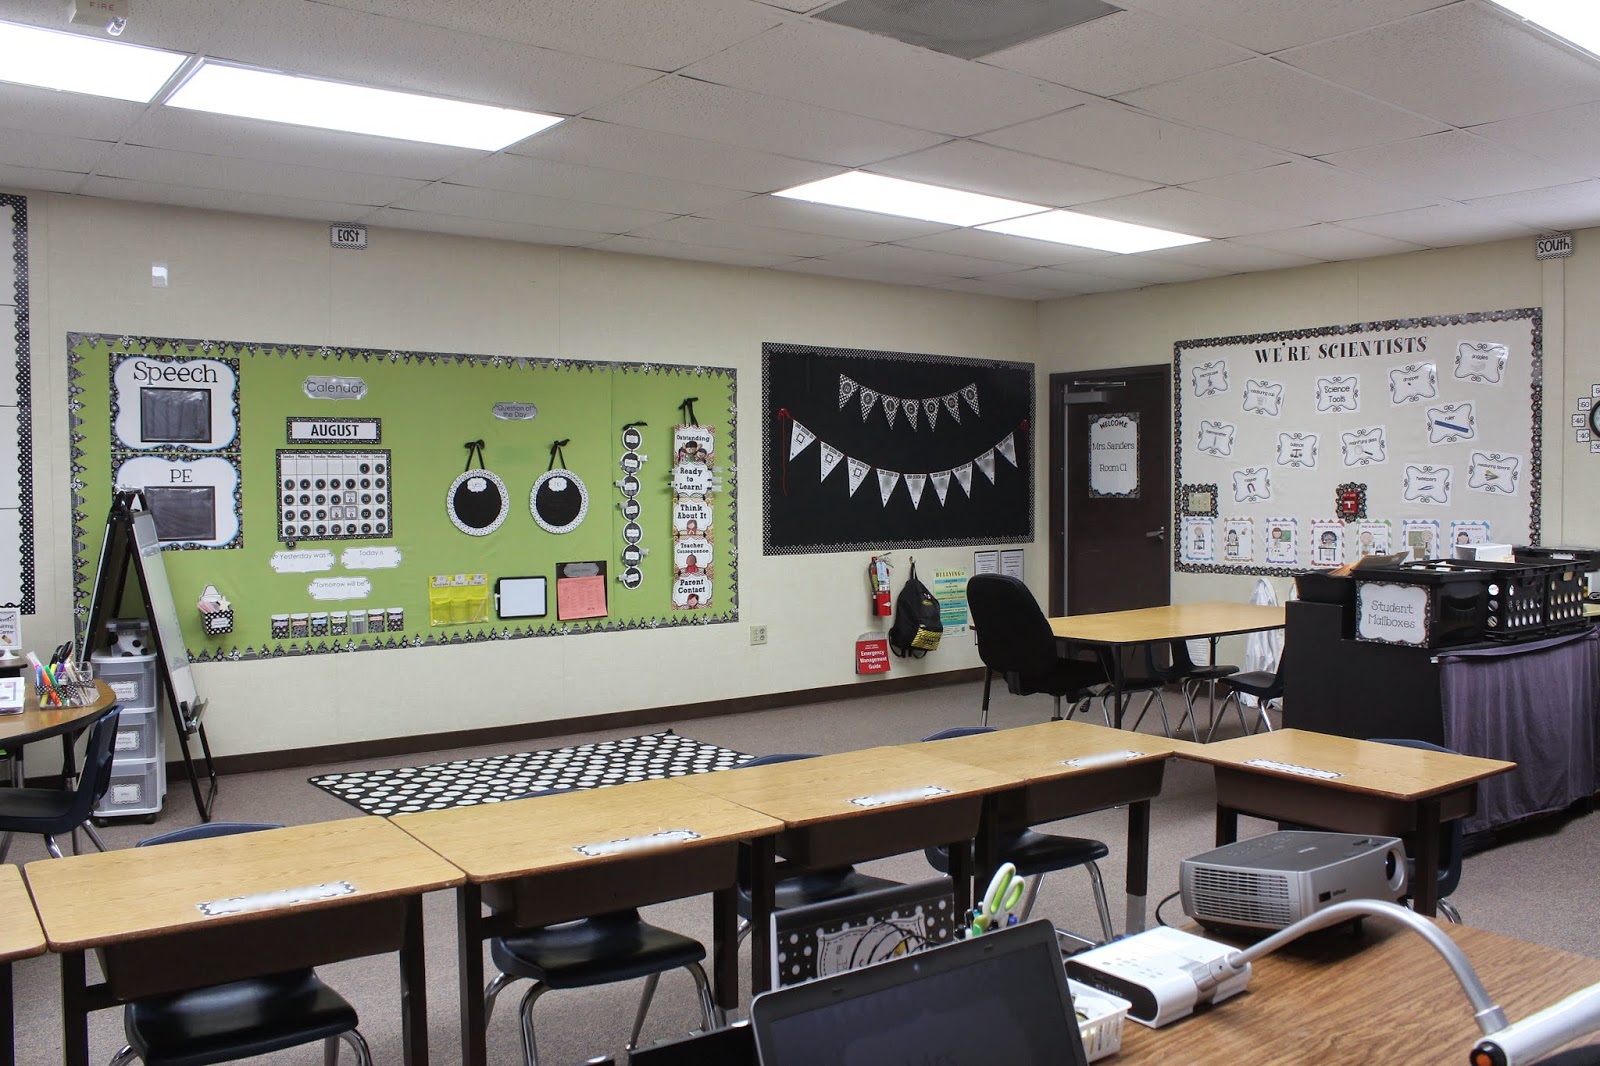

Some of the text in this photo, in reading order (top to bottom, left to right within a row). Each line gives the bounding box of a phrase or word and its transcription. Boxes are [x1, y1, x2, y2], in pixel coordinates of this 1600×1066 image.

[89, 2, 115, 11] FIRE
[1254, 336, 1427, 364] WE'RE SCIENTISTS
[133, 361, 218, 385] Speech
[306, 380, 363, 394] Calendar
[1324, 385, 1351, 394] Science
[1099, 419, 1128, 429] WELCOME
[310, 424, 360, 437] AUGUST
[676, 434, 710, 443] Outstanding
[1107, 441, 1135, 450] Sanders
[169, 469, 193, 484] PE
[680, 468, 703, 476] Ready
[680, 504, 703, 512] Think
[1371, 600, 1413, 615] Student
[1368, 615, 1416, 629] Mailboxes
